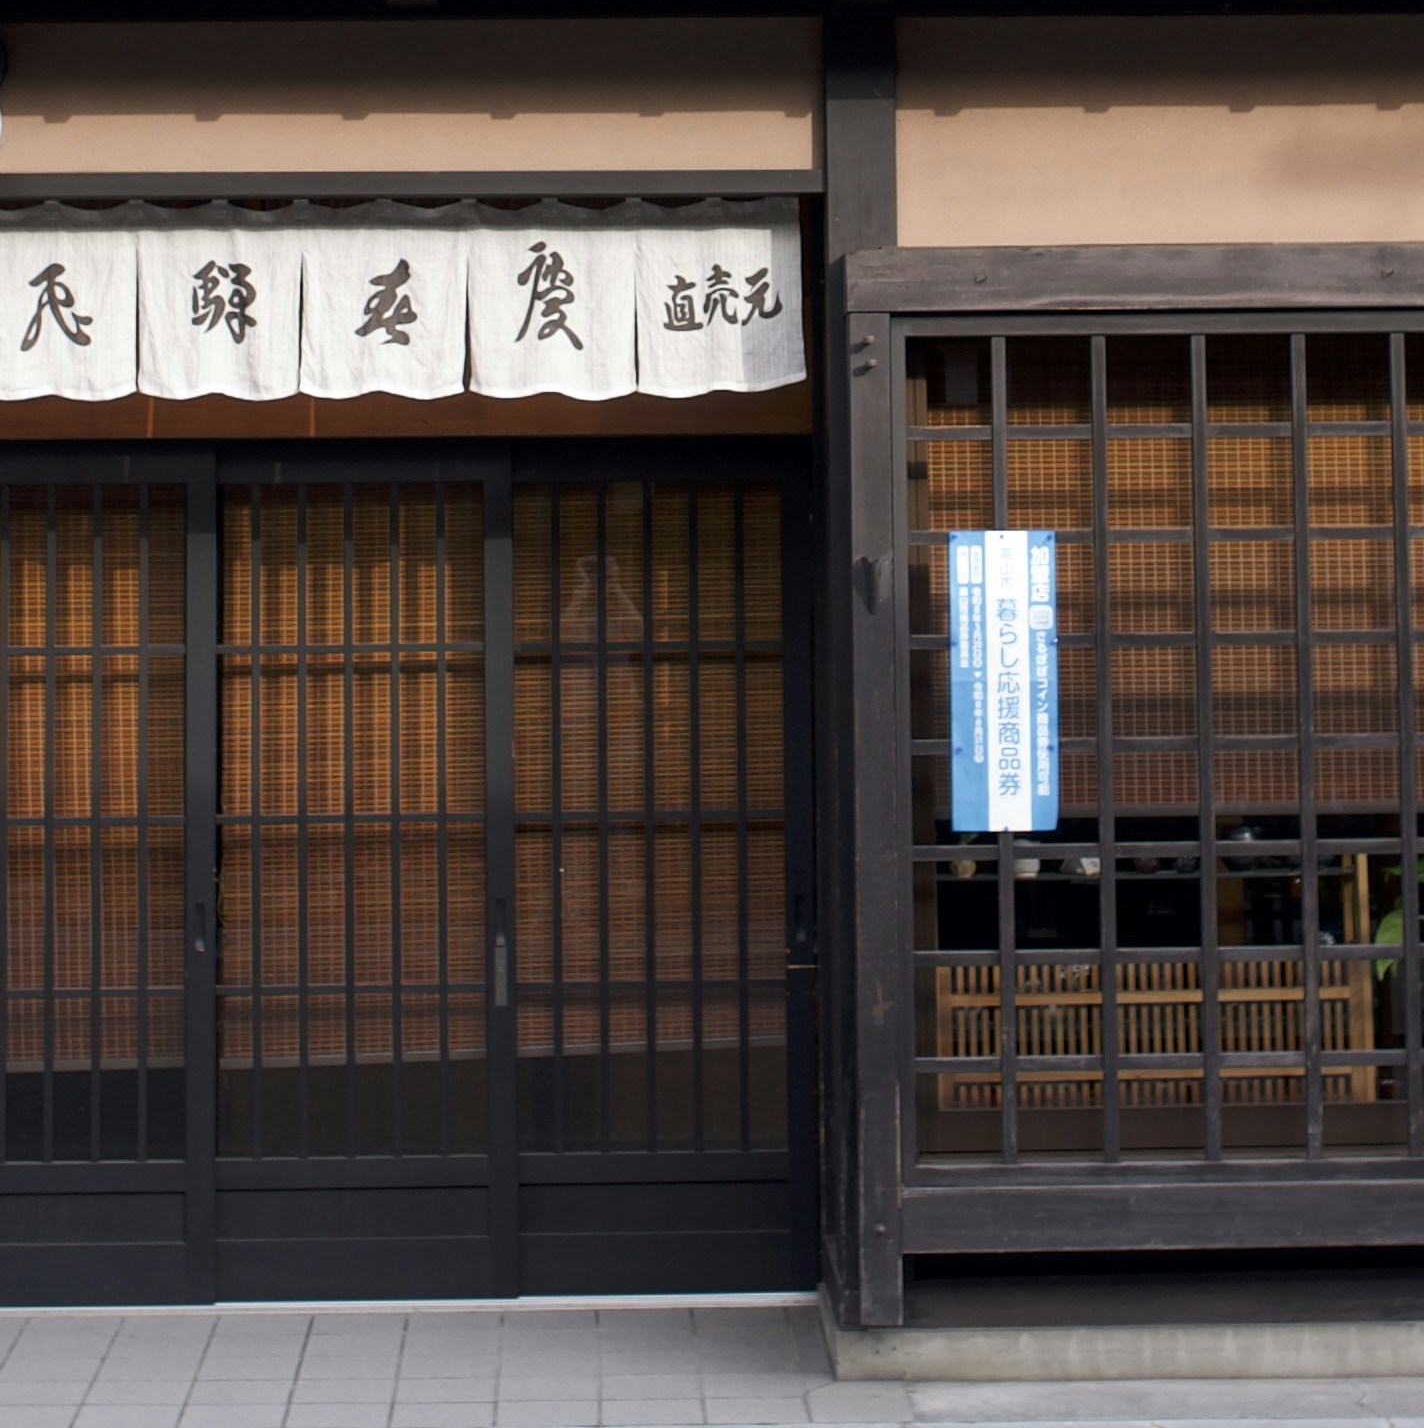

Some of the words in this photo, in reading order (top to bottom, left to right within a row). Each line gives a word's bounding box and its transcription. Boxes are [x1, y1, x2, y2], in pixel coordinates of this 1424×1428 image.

[663, 265, 783, 332] 直売元
[996, 598, 1021, 795] 暮らし応援商品券
